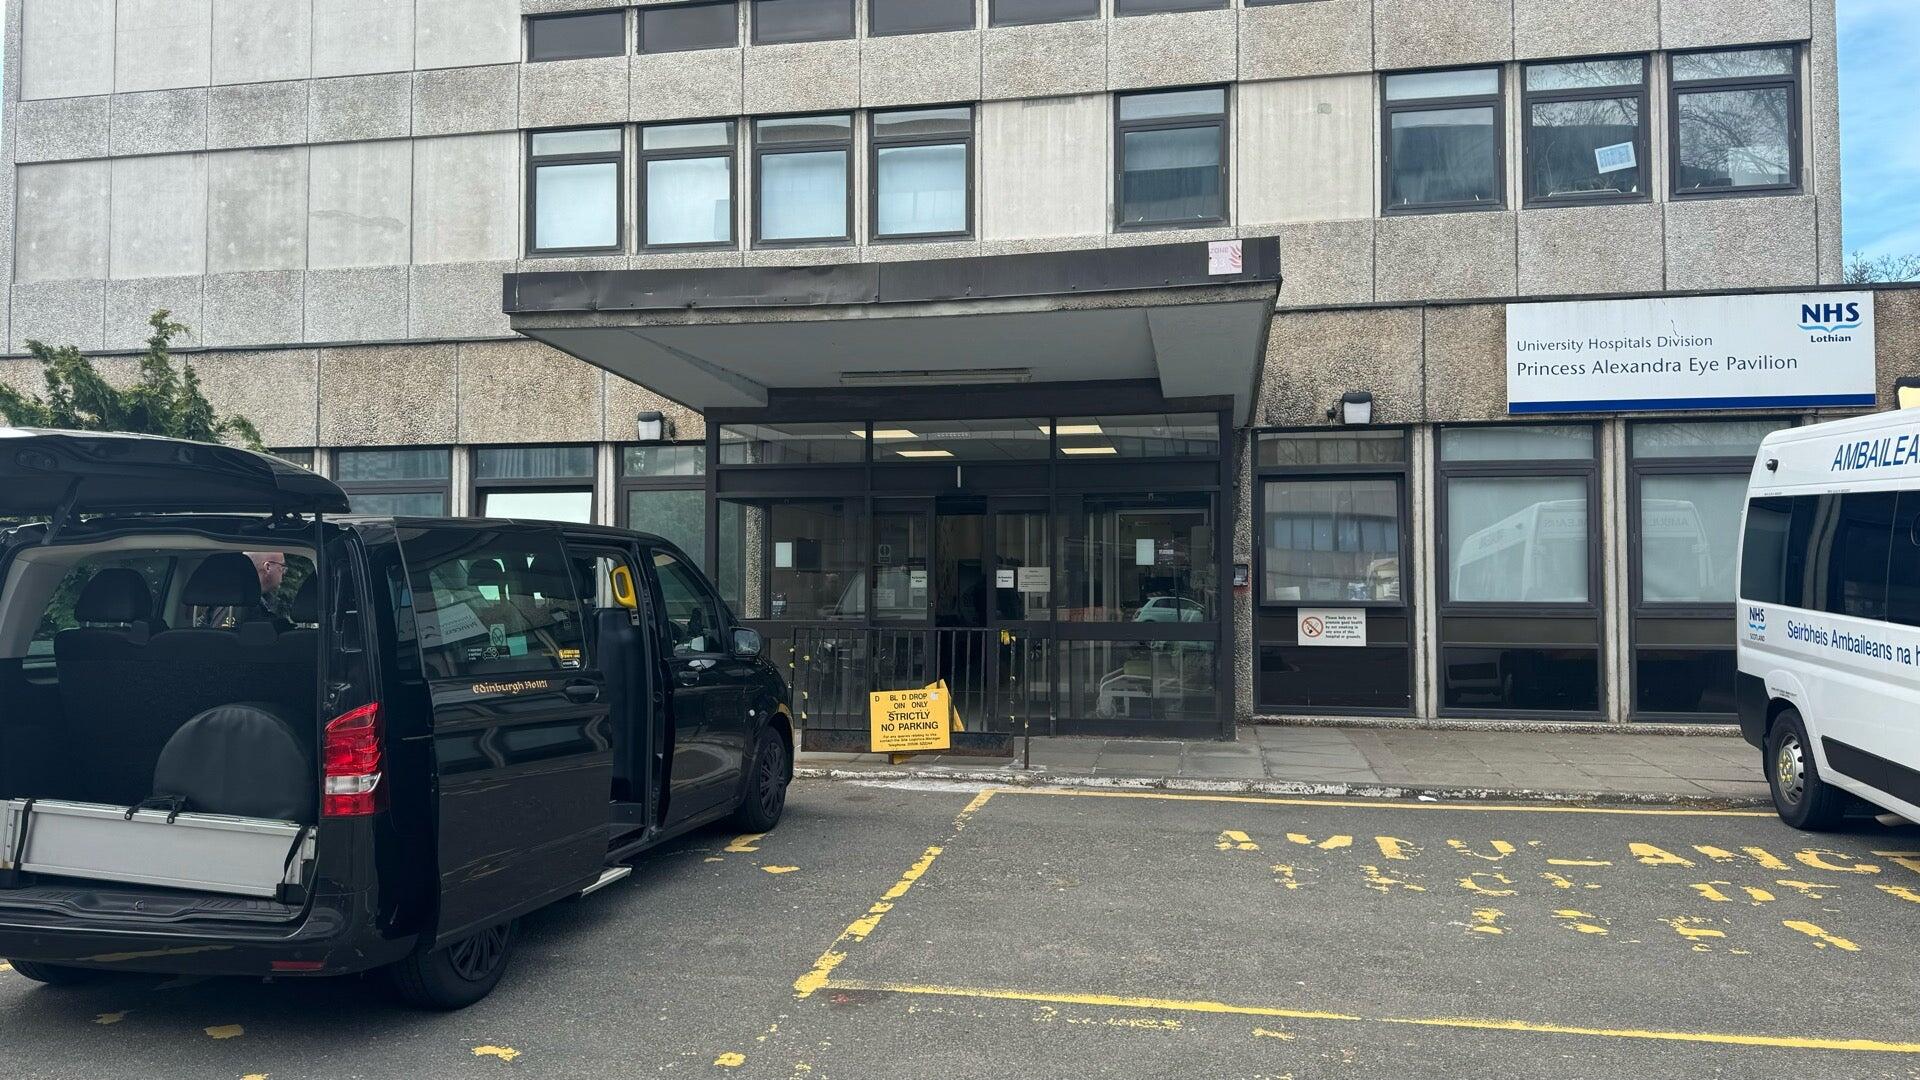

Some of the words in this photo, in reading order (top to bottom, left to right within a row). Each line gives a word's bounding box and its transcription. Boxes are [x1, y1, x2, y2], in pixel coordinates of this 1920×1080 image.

[1802, 302, 1859, 323] NHS
[1517, 339, 1584, 353] University
[1589, 336, 1652, 352] Hospitals
[1657, 335, 1713, 347] Division
[1810, 334, 1851, 343] Lothian
[1517, 362, 1586, 376] Princess
[1592, 358, 1681, 374] Alexandra
[1689, 357, 1719, 376] Eye
[1727, 355, 1798, 370] Pavilion
[1830, 434, 1920, 471] AMBAILEA
[1749, 606, 1765, 622] NHS
[1787, 620, 1828, 646] Seirbheis
[1831, 629, 1892, 661] Ambaileans
[1897, 647, 1911, 665] na
[472, 682, 524, 694] Edinburgh
[889, 712, 930, 721] STRICTLY
[881, 723, 894, 731] NO
[899, 721, 938, 730] PARKING
